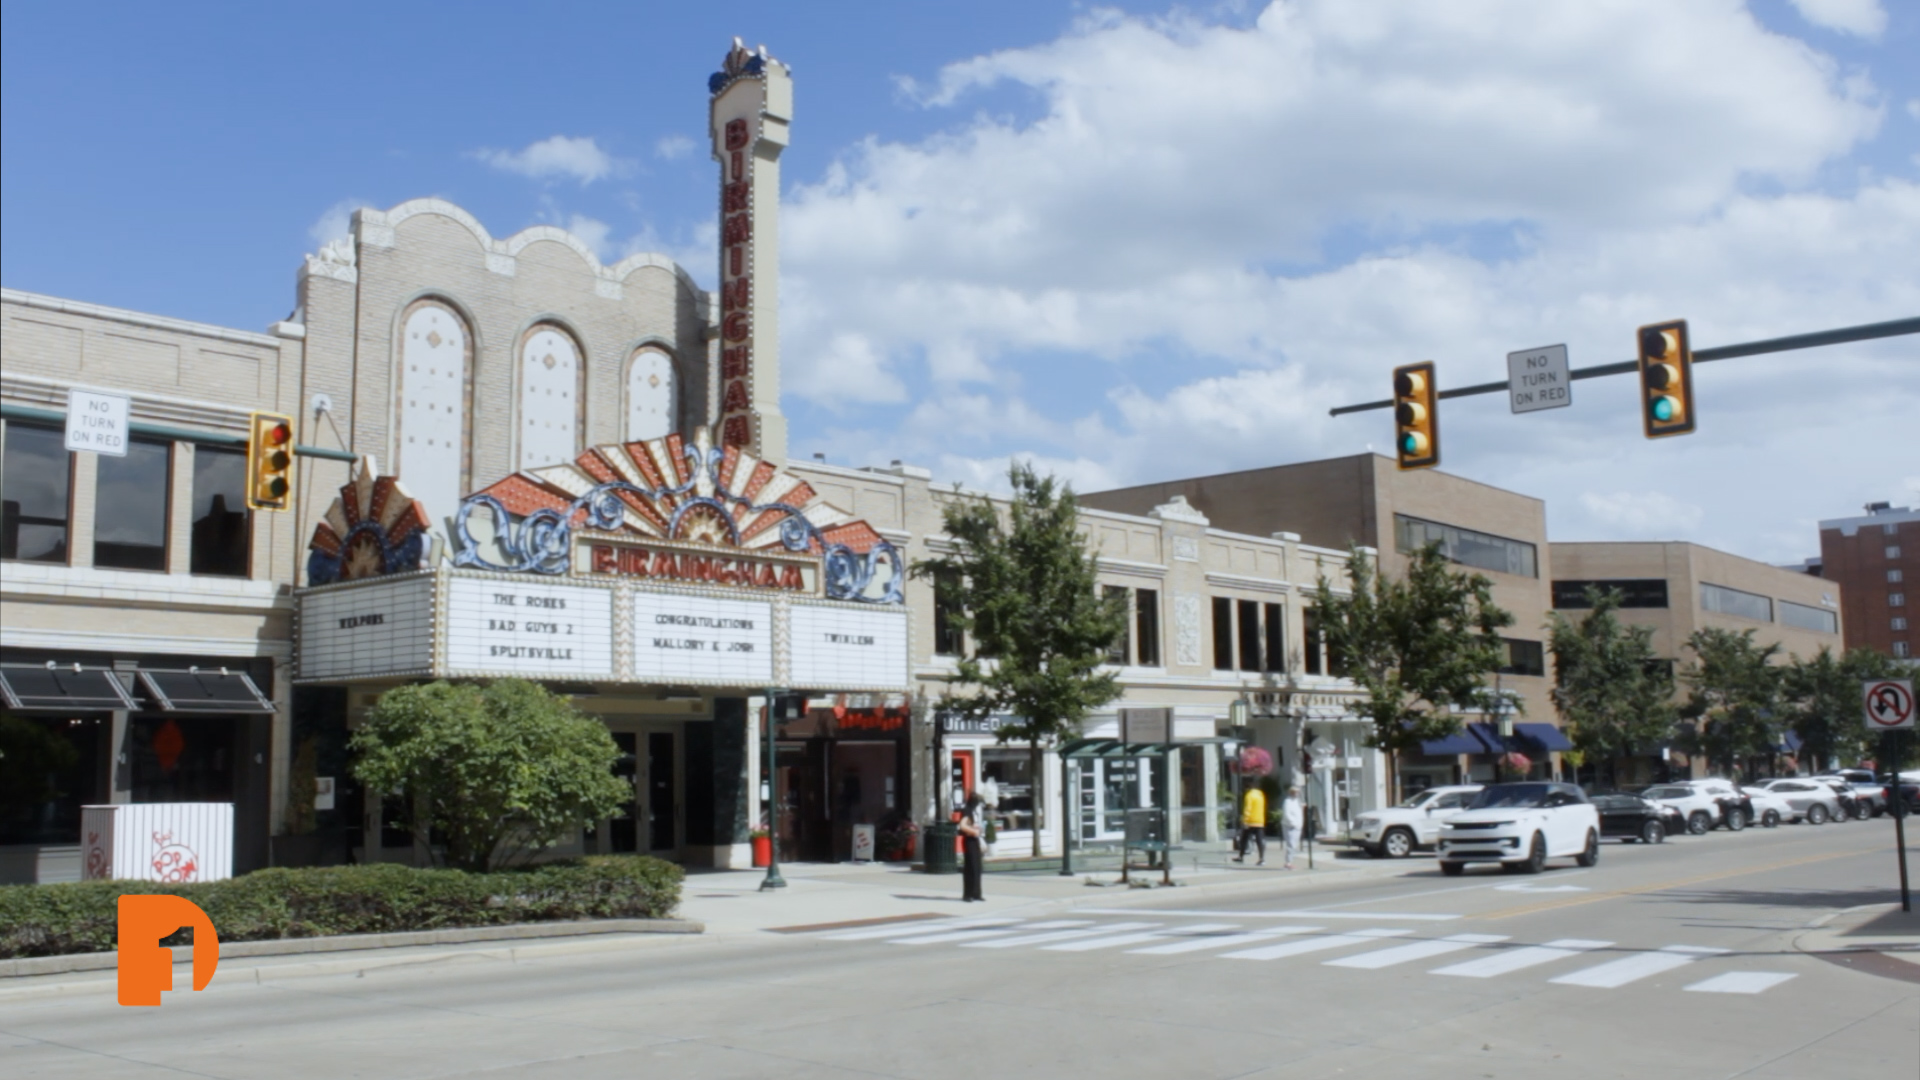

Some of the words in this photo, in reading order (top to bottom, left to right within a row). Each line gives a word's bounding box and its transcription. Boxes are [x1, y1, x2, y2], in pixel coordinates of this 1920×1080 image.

[723, 118, 750, 446] BIRMINGHAM
[1526, 355, 1548, 369] NO
[1522, 371, 1558, 387] TURN
[1515, 392, 1533, 405] ON
[1539, 387, 1566, 401] RED
[89, 400, 110, 413] NO
[82, 415, 116, 430] TURN
[72, 430, 90, 442] ON
[96, 433, 122, 447] RED
[592, 544, 805, 592] BIRMINGHAM
[493, 593, 517, 607] THE
[526, 595, 567, 610] ROSES
[489, 619, 516, 632] BAD
[525, 621, 558, 635] GUYS
[566, 623, 574, 635] 2
[655, 613, 754, 630] CONGRATULATIONS
[490, 645, 573, 661] SPLITSVILLE
[653, 637, 704, 651] MALLORY
[727, 642, 754, 653] JOSH
